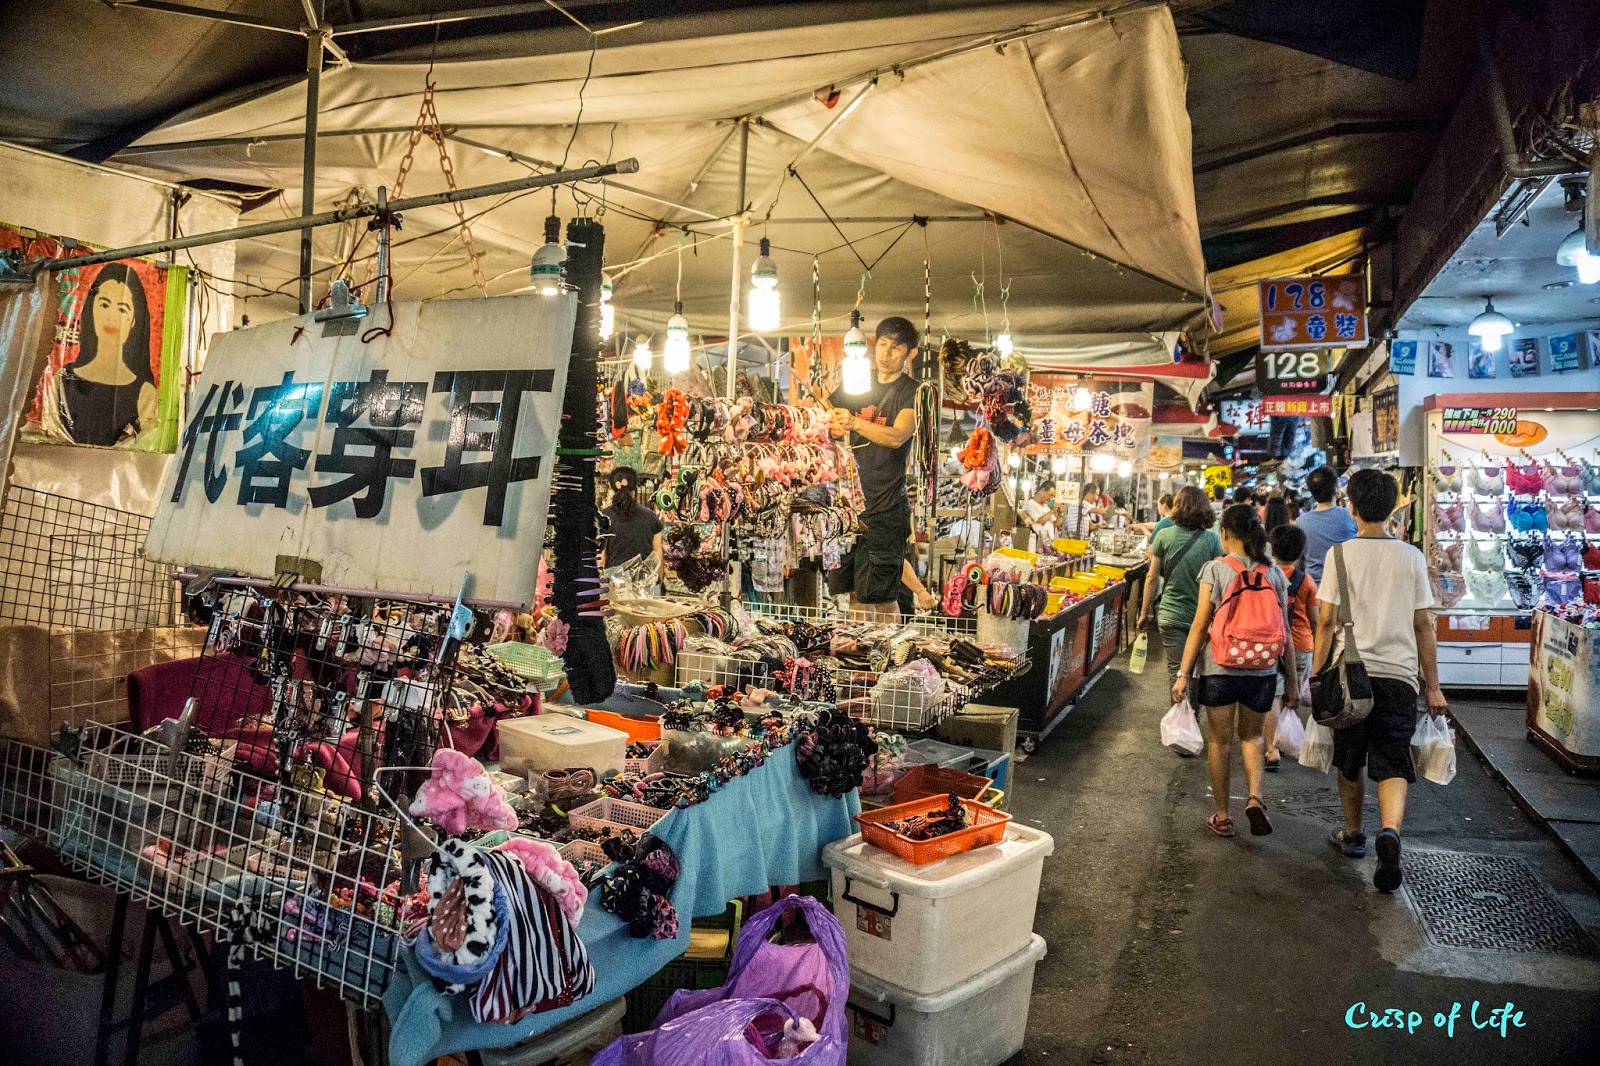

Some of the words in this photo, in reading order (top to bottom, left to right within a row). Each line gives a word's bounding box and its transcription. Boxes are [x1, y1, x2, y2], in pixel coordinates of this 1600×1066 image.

[1306, 313, 1358, 339] 童裝
[1263, 352, 1320, 379] 128
[1039, 418, 1136, 448] 薑母茶塊
[170, 369, 556, 528] 代客穿耳
